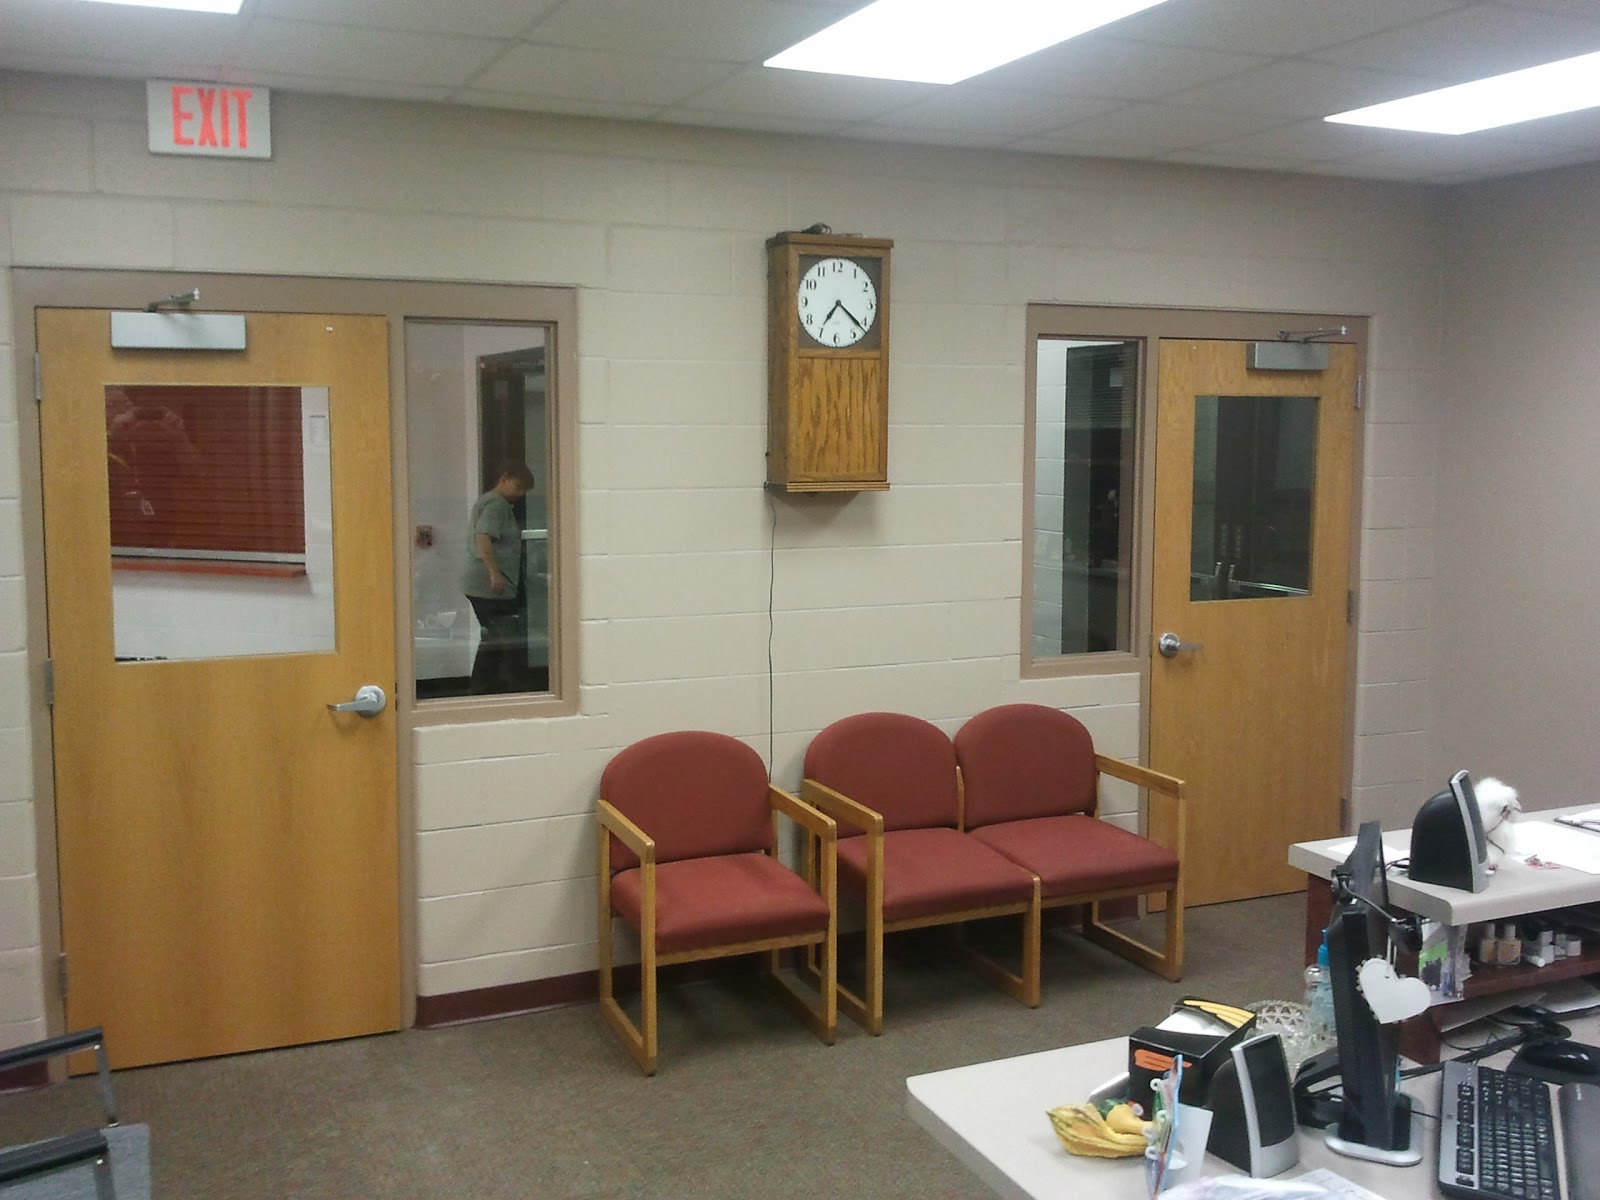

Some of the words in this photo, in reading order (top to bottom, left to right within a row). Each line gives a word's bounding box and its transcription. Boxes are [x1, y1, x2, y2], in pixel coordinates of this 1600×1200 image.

[171, 85, 253, 149] EXIT
[817, 266, 826, 277] 11
[832, 262, 844, 272] 12
[805, 279, 817, 290] 10
[862, 281, 869, 292] 2
[801, 296, 808, 308] 9
[866, 300, 874, 310] 3
[806, 314, 813, 325] 8
[860, 316, 867, 327] 4
[818, 327, 824, 338] 7
[850, 329, 857, 339] 5
[833, 333, 841, 344] 6
